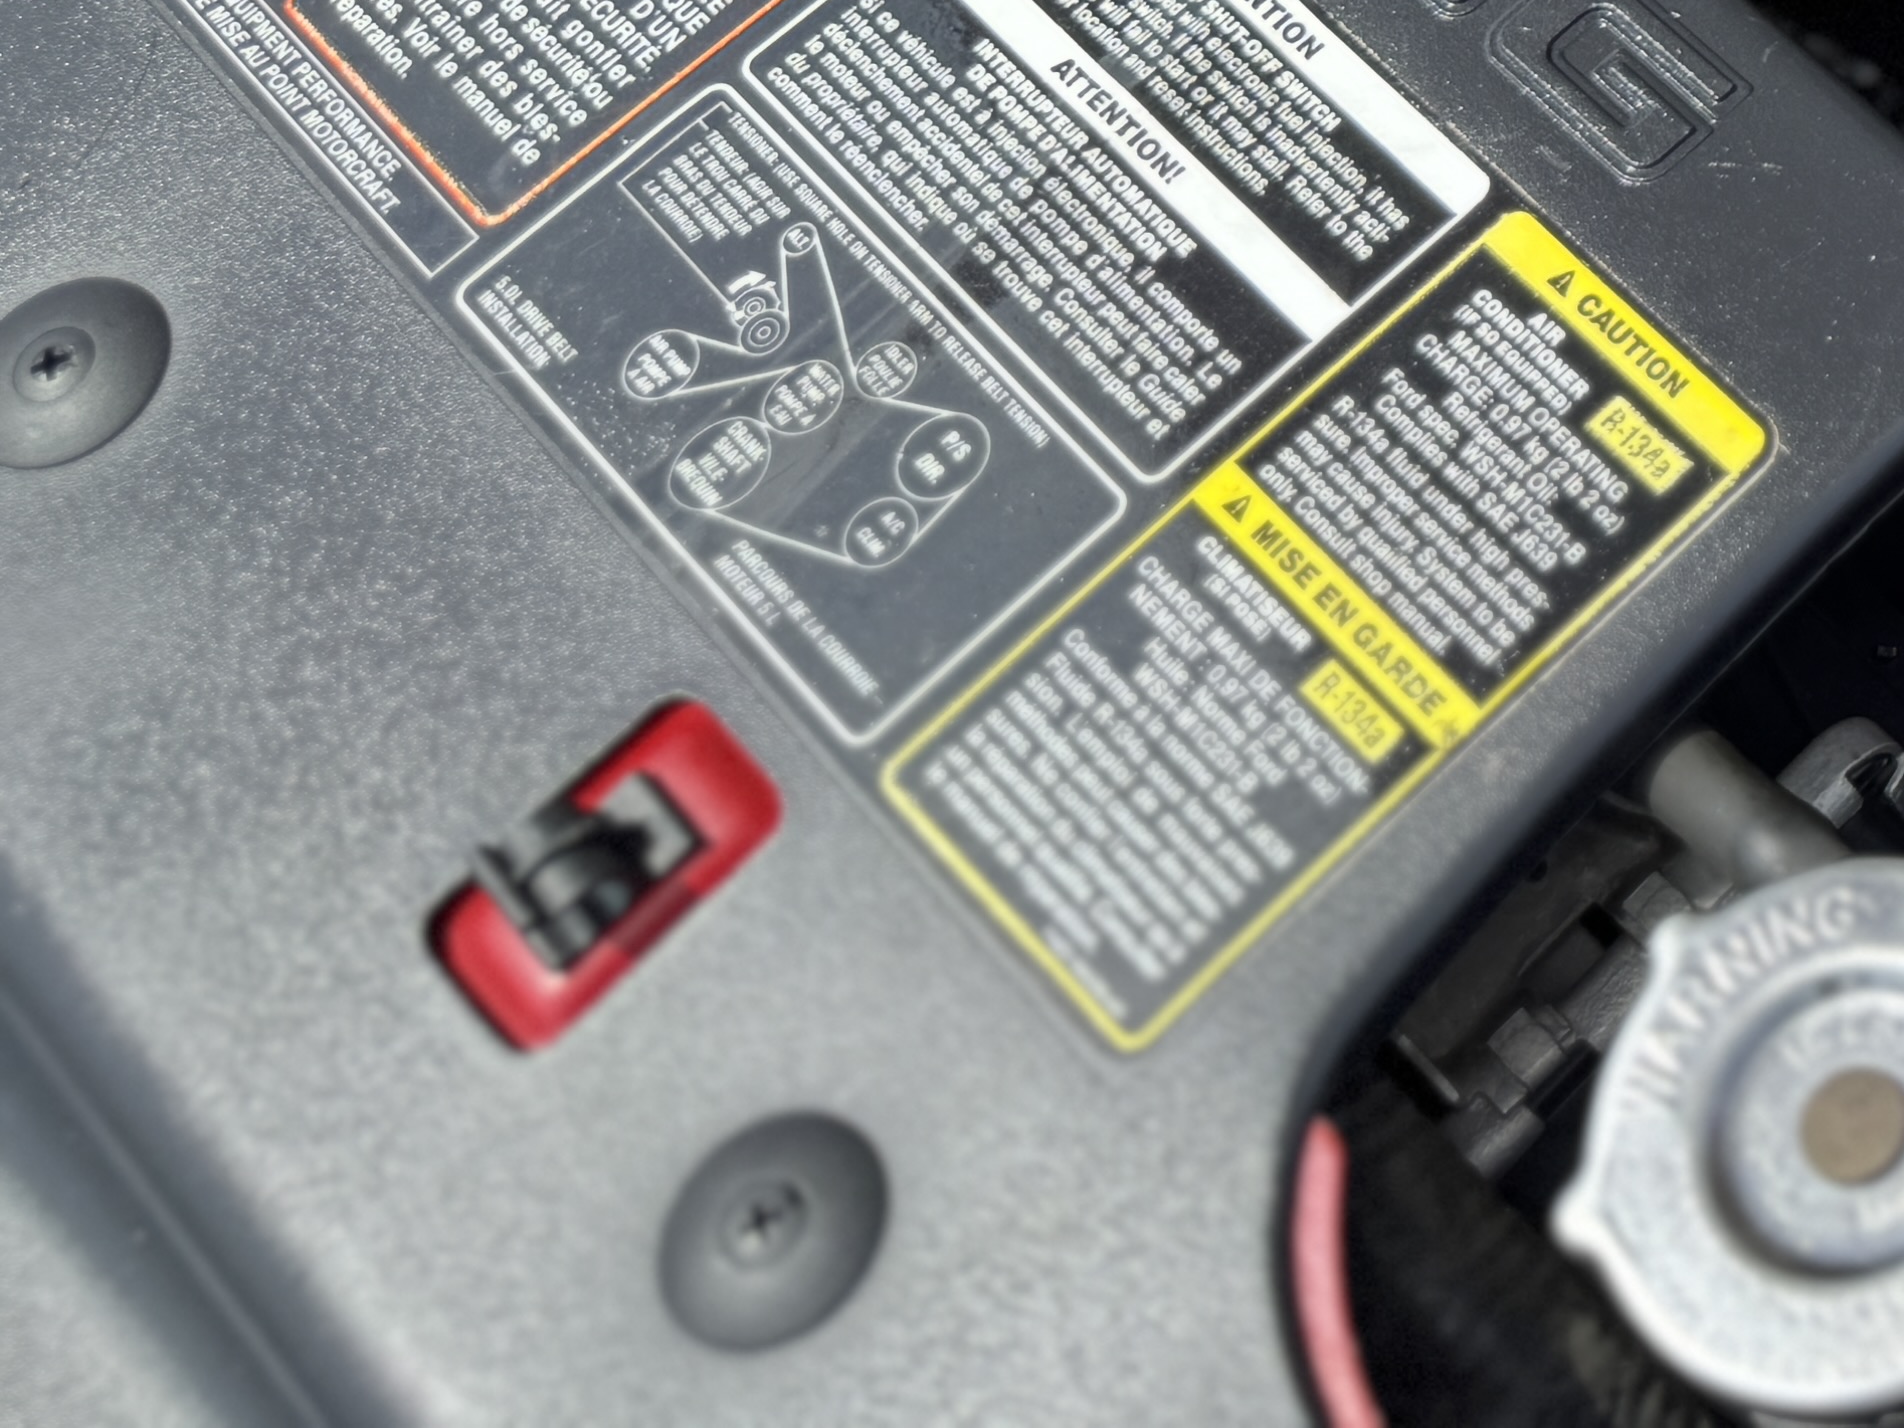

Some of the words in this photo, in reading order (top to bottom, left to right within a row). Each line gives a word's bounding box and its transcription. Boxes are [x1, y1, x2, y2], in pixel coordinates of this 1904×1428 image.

[1200, 0, 1282, 71] SHUT-OFF
[1275, 70, 1340, 131] SWITCH
[290, 62, 405, 179] PERFORMANCE.
[974, 39, 1087, 148] INTERRUPTEUR
[1082, 148, 1195, 256] AUTOMATIQUE
[1051, 59, 1184, 182] ATTENTION!
[478, 290, 549, 366] INSTALLATION
[494, 275, 522, 305] 5.0L
[516, 299, 553, 336] DRIVE
[545, 331, 577, 361] BELT
[1577, 294, 1688, 397] CAUTION
[914, 453, 944, 483] DIR.
[941, 430, 971, 460] P/S
[1600, 408, 1670, 477] R-134a
[1251, 520, 1319, 588] MISE
[1313, 583, 1356, 626] EN
[1352, 622, 1445, 715] GARDE
[1314, 671, 1384, 748] R-134a
